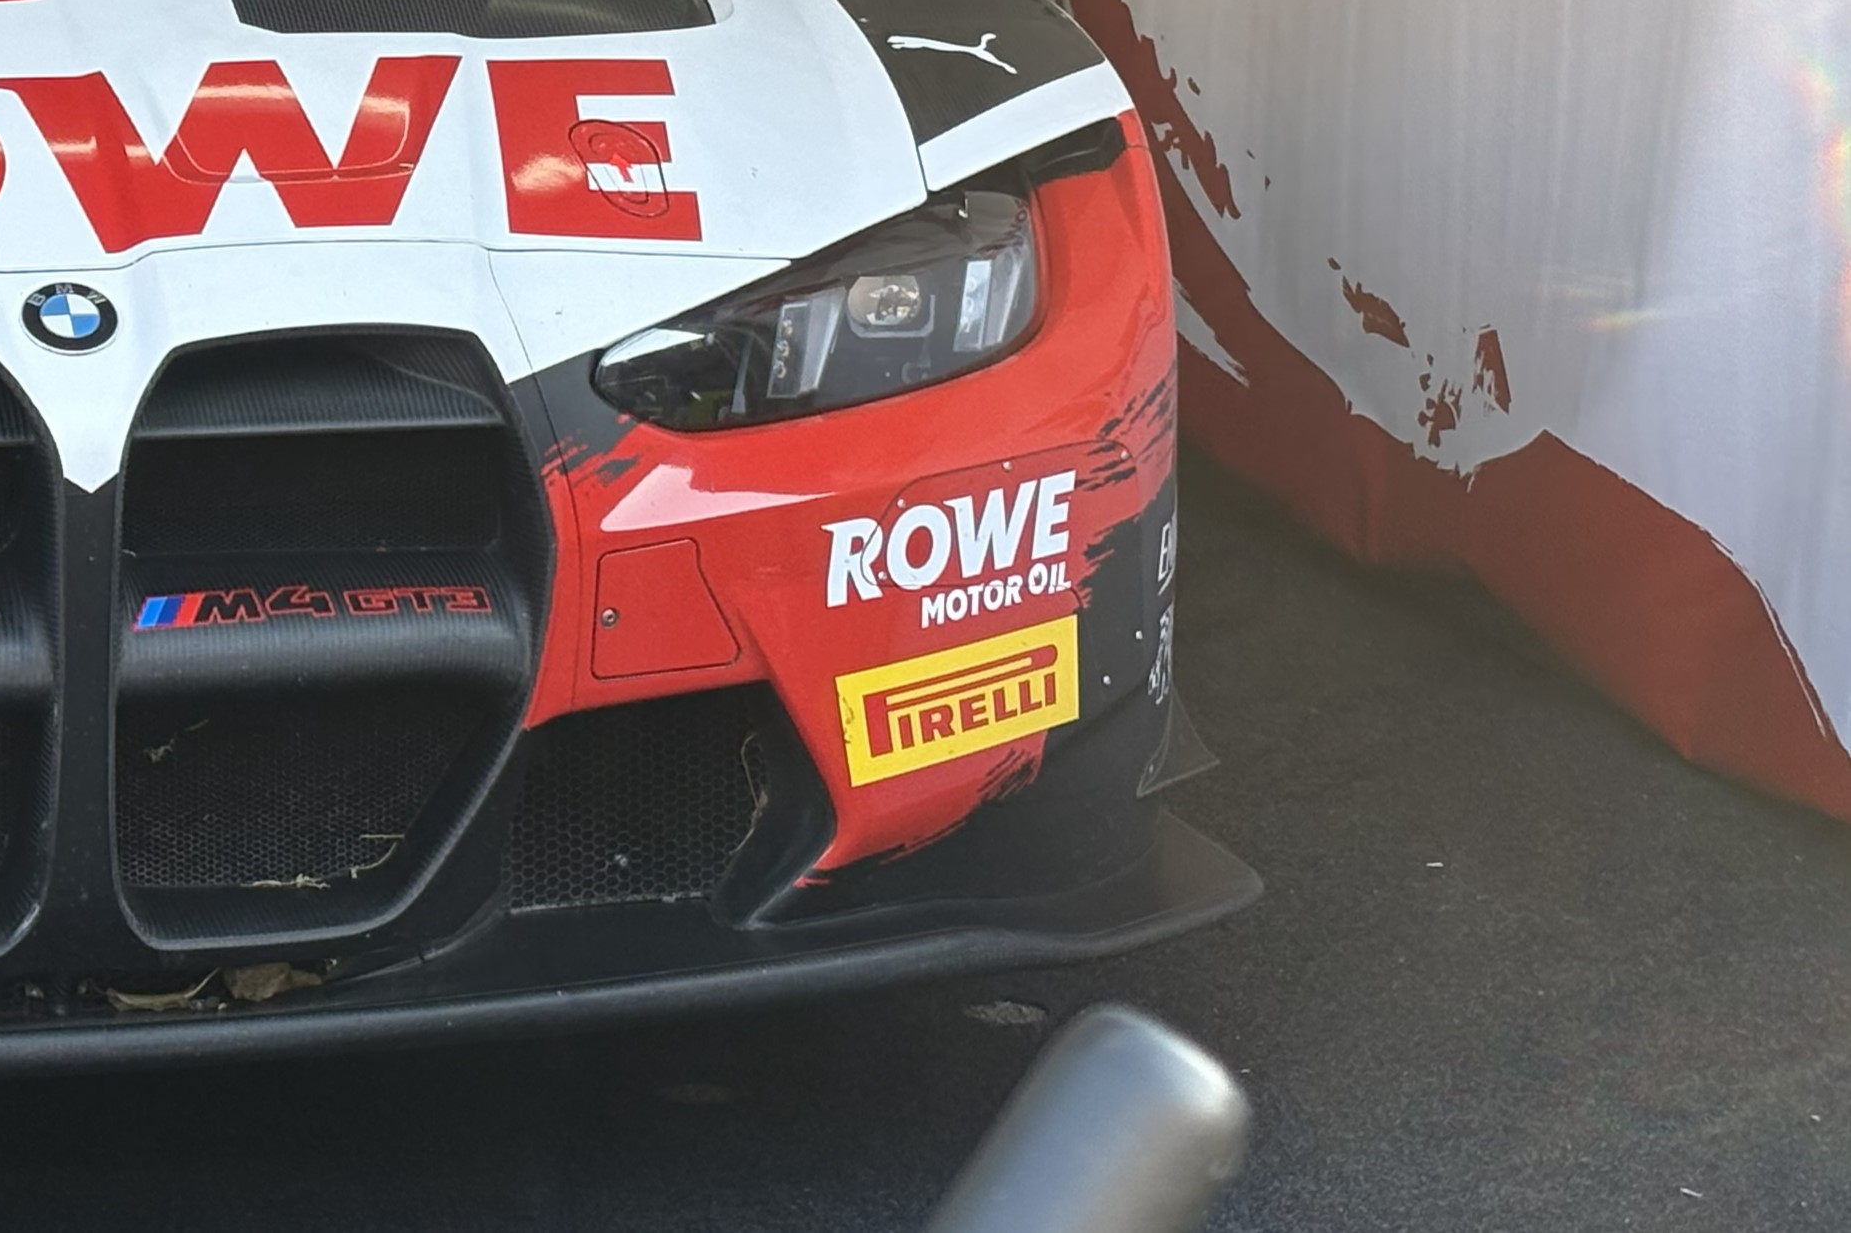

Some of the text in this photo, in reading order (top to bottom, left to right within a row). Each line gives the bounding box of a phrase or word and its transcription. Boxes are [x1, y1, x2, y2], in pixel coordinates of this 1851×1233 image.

[821, 470, 1077, 608] ROWE
[194, 585, 493, 624] M4 GT3
[921, 561, 1072, 629] MOTOR OIL
[863, 644, 1058, 758] PIRELLI
